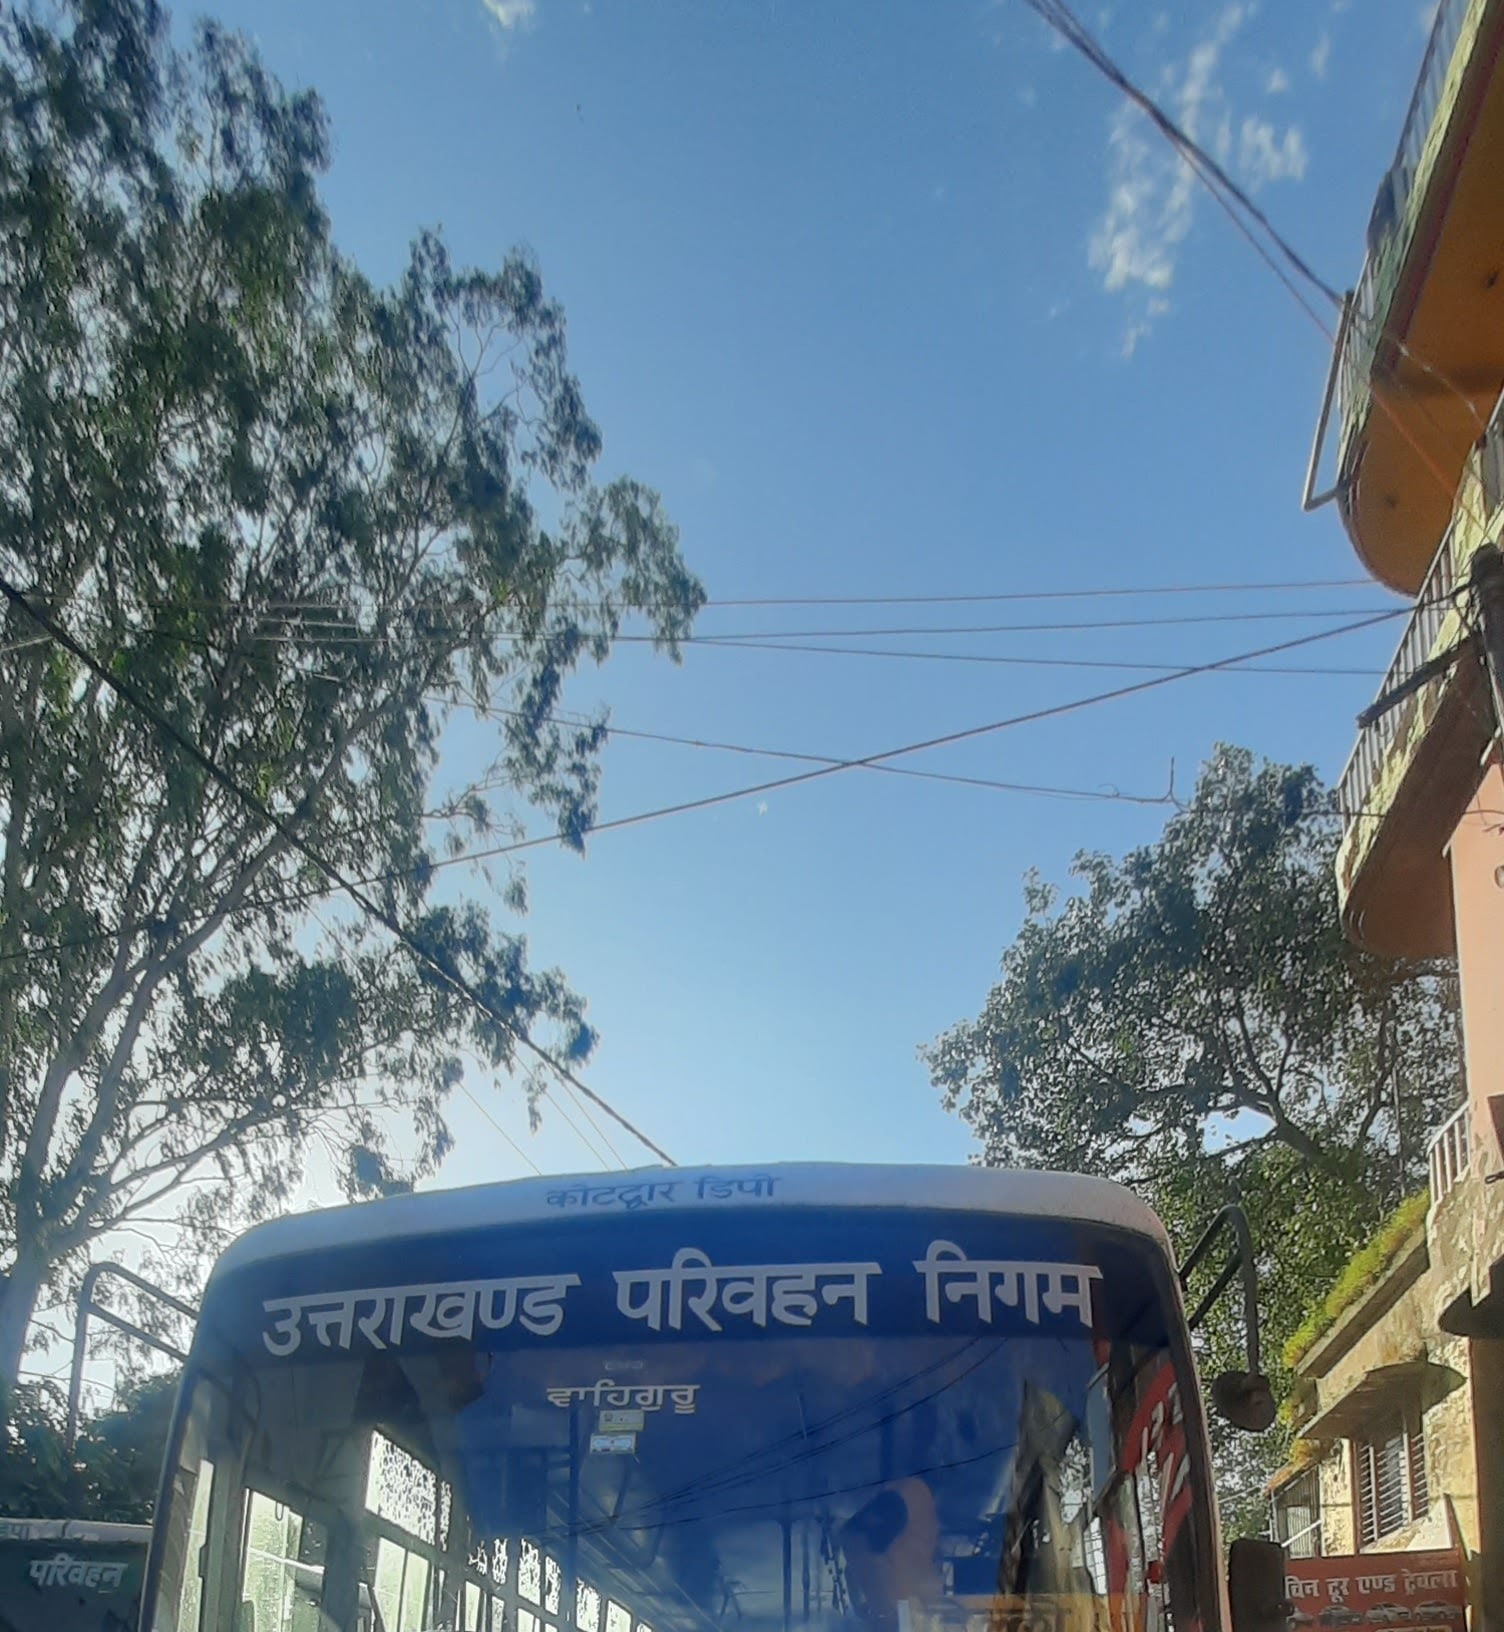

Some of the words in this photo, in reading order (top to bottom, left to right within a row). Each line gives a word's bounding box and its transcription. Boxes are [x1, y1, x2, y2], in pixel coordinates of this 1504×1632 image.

[546, 1182, 682, 1209] कोटद्वार
[695, 1173, 782, 1200] डिपो
[261, 1273, 582, 1357] उत्तराखण्ड
[612, 1248, 882, 1332] परिवहन
[913, 1240, 1103, 1328] निगम
[546, 1379, 701, 1414] ਵਾਹਿਗੁਰੂ
[29, 1552, 128, 1588] परिवहन
[1355, 1574, 1396, 1593] एण्ड
